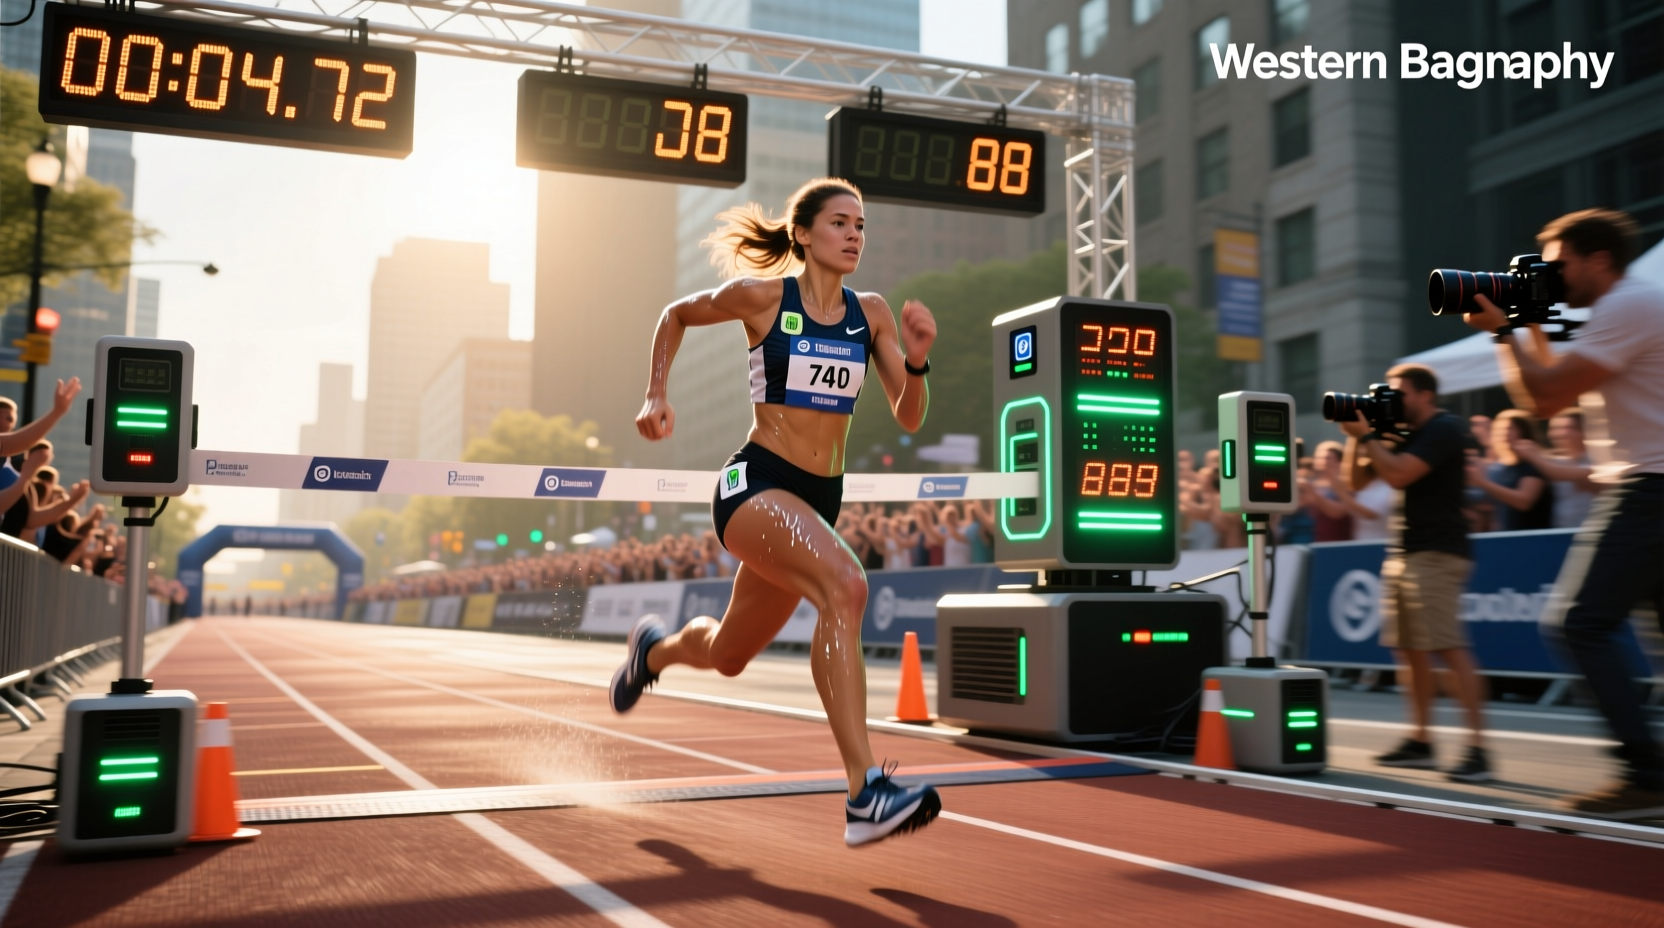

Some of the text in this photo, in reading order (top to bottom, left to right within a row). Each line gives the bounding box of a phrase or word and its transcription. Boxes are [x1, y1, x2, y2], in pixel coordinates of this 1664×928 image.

[60, 27, 396, 130] 00:04.72
[966, 137, 1032, 195] 88
[809, 364, 850, 389] 740
